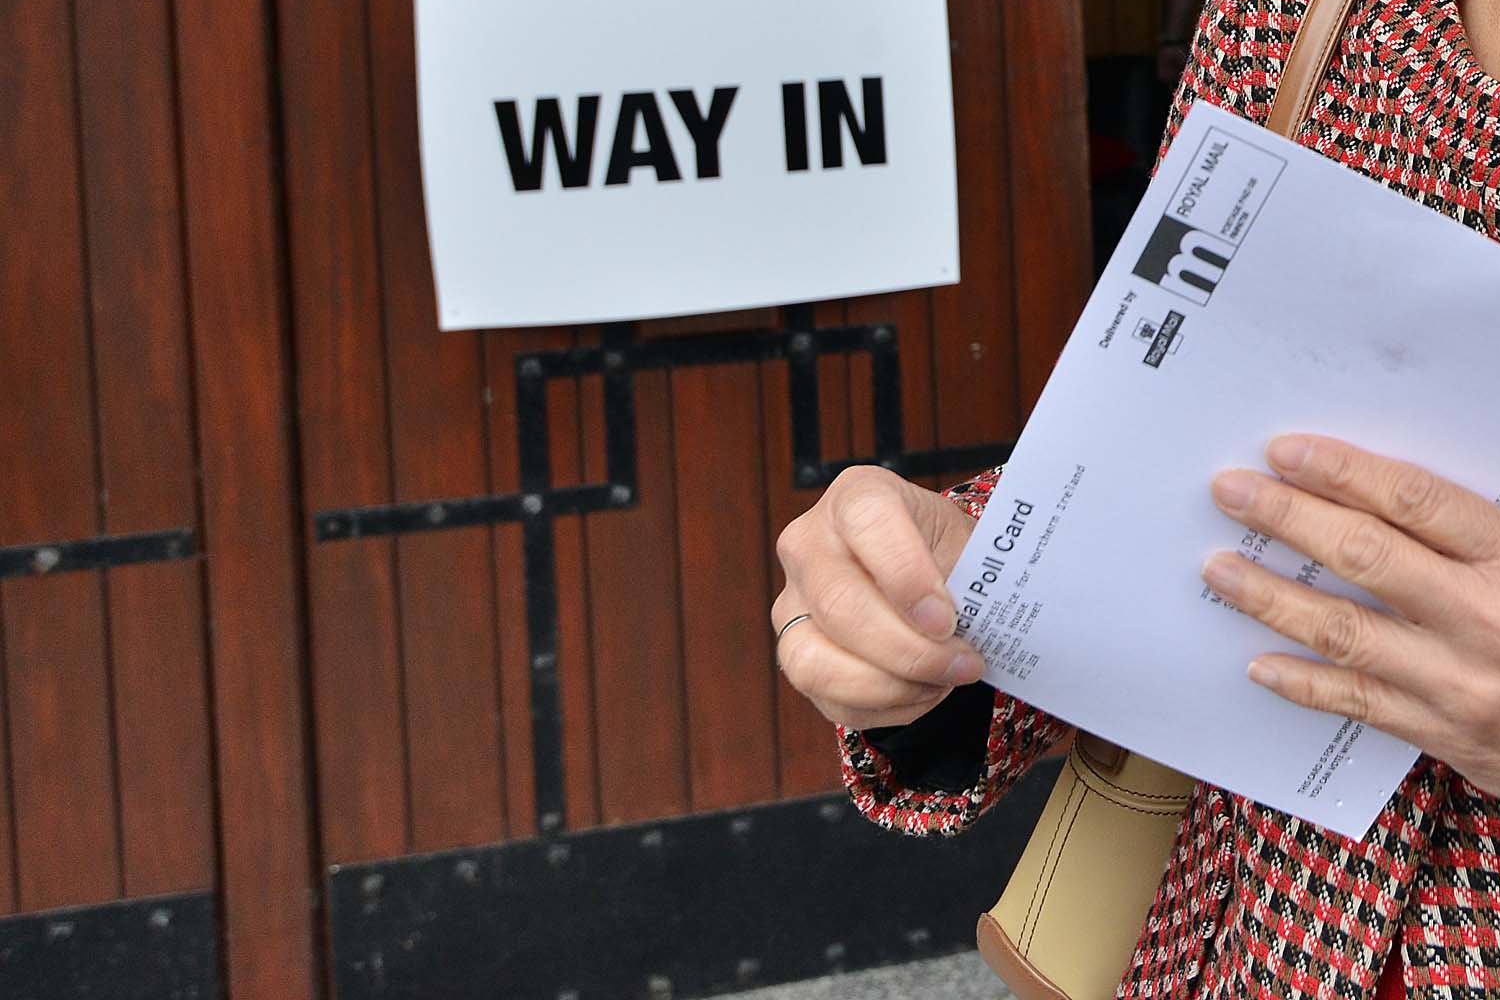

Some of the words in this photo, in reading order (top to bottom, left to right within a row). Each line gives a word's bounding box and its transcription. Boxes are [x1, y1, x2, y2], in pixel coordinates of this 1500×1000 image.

[494, 86, 739, 192] WAY
[781, 77, 887, 171] IN
[1175, 175, 1209, 217] ROYAL
[1200, 141, 1228, 173] MAIL
[1098, 304, 1128, 348] Delivered
[1123, 290, 1136, 302] by
[1145, 334, 1170, 365] Royal
[1160, 312, 1181, 337] Mail
[969, 557, 1004, 595] Poll
[992, 499, 1033, 553] Card
[995, 590, 1019, 624] Office
[1015, 569, 1031, 586] for
[1028, 514, 1059, 564] Northern
[1055, 464, 1086, 510] Ireland
[1007, 601, 1028, 628] House
[1019, 601, 1042, 633] Street
[1296, 779, 1311, 794] THIS
[1307, 762, 1323, 780] CARD
[1322, 742, 1336, 756] FOR
[1318, 770, 1332, 784] CAN
[1328, 753, 1343, 770] VOTE
[1340, 723, 1364, 753] WITHOUT
